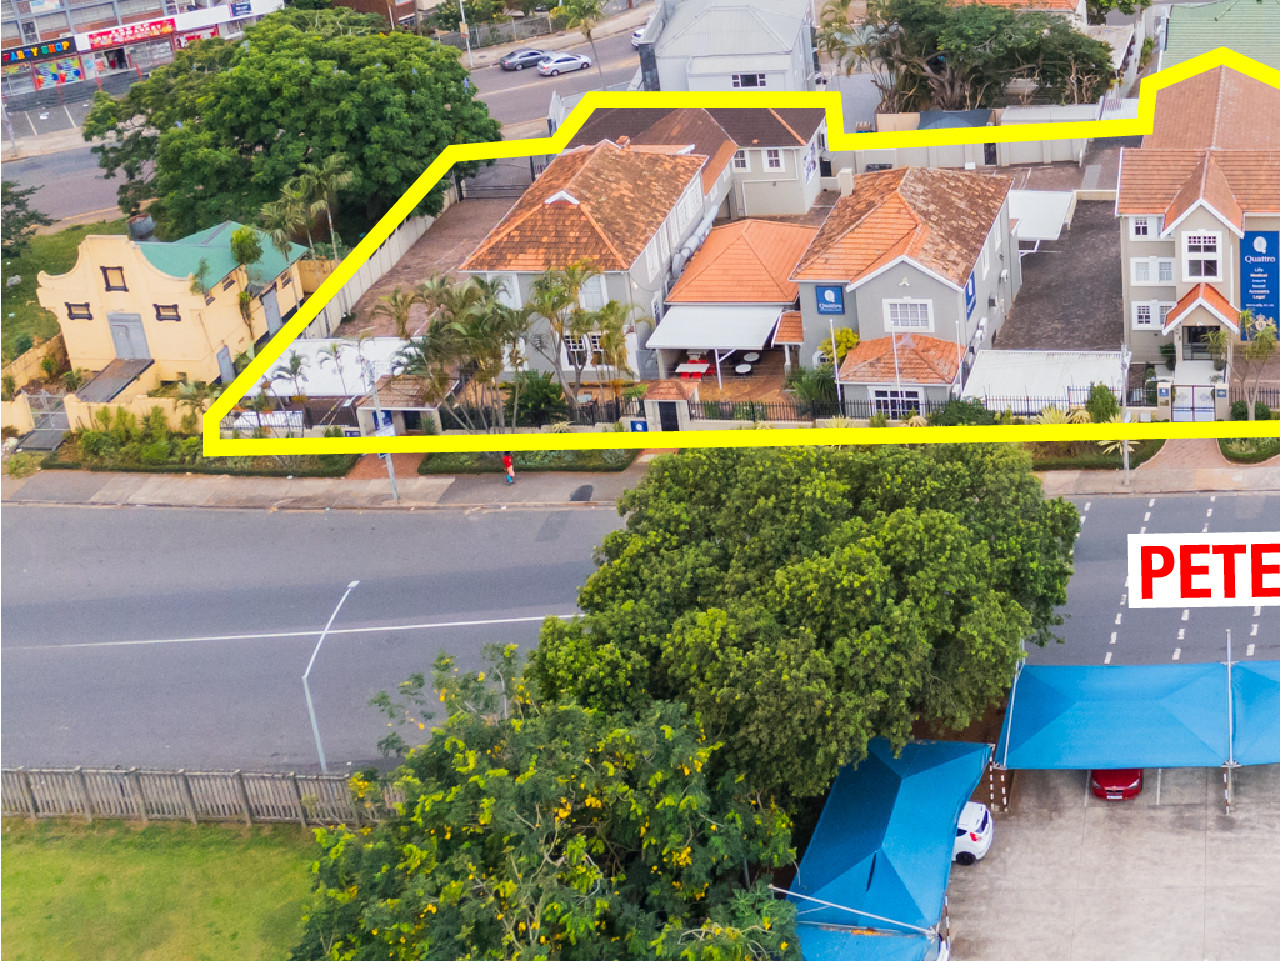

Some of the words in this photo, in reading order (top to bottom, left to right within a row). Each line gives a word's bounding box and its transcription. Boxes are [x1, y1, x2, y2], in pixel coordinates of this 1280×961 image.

[3, 46, 38, 61] PARTY
[41, 41, 70, 55] SHOP
[1244, 255, 1276, 264] Quattro
